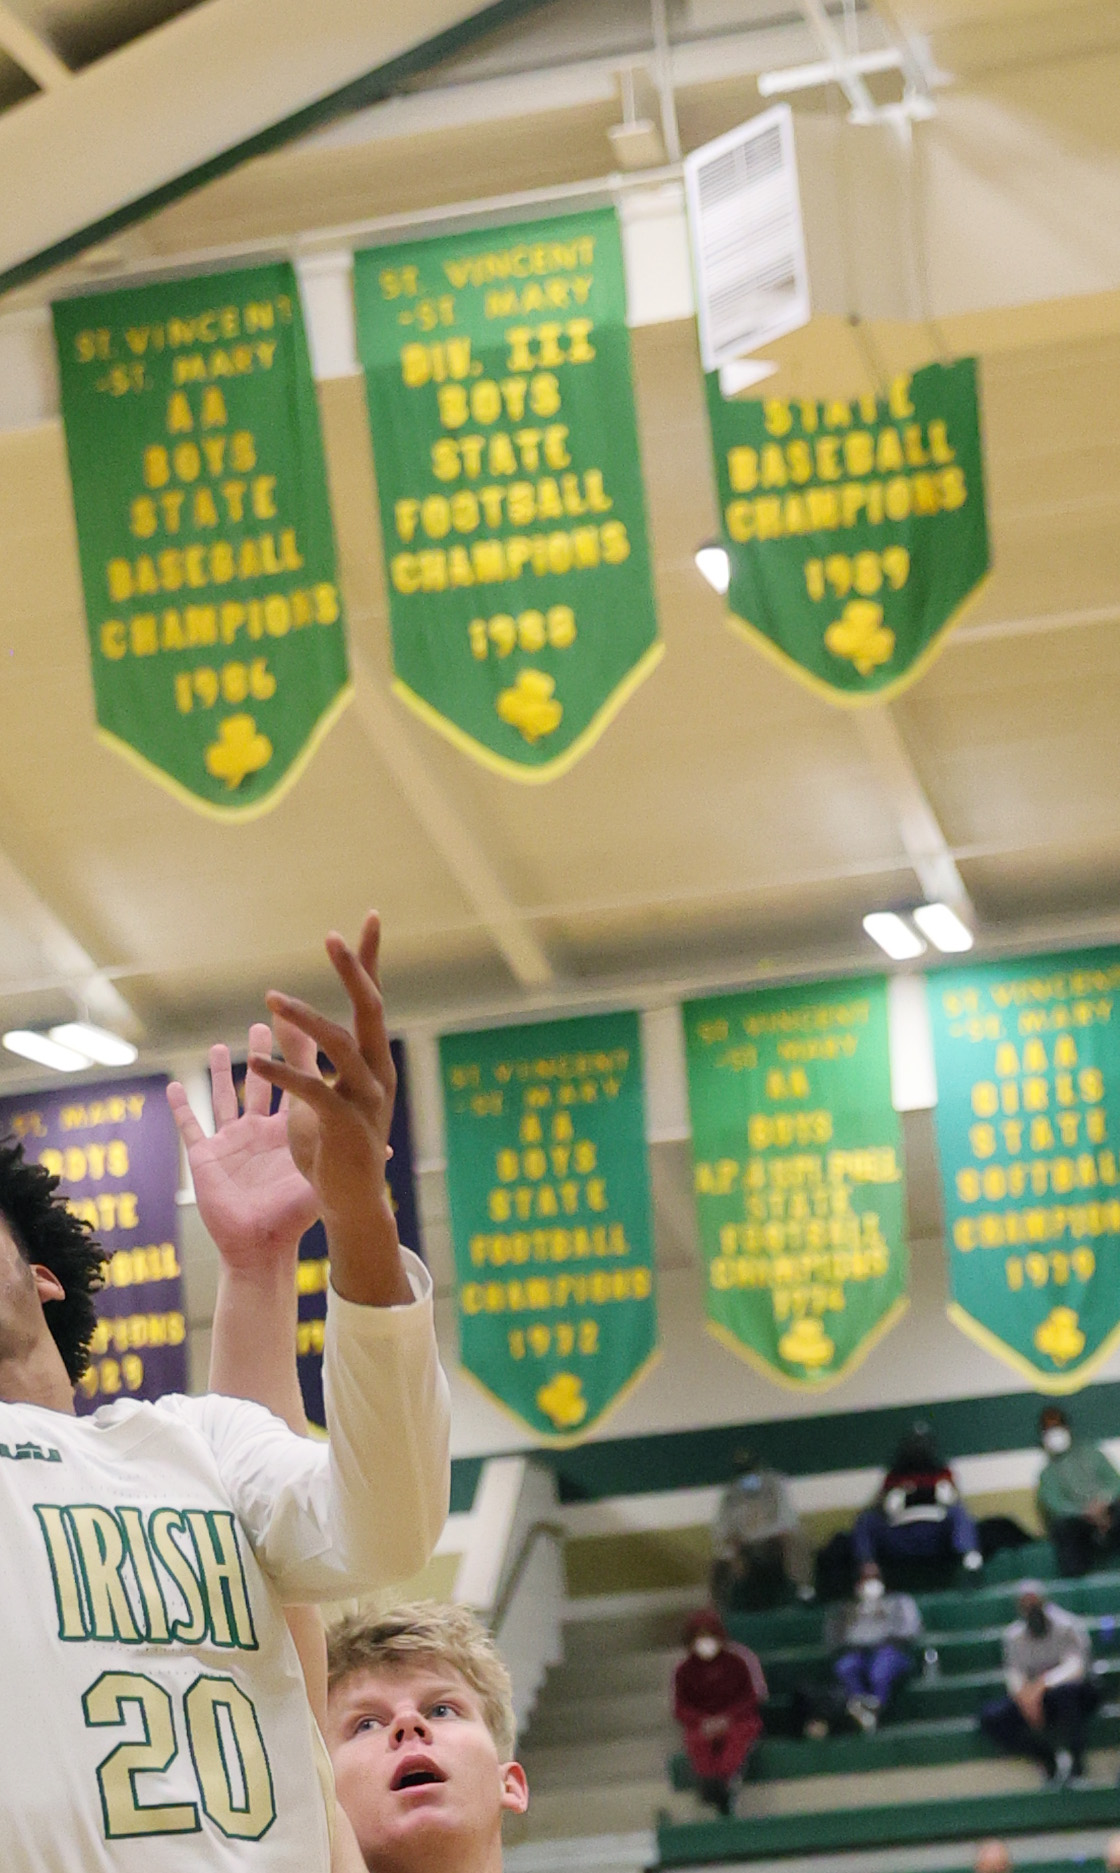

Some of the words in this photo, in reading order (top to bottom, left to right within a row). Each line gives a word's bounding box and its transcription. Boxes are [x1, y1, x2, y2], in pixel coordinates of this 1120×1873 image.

[444, 235, 596, 290] VINCENT
[485, 275, 593, 319] MARY
[173, 339, 277, 386] MARY
[400, 337, 484, 388] DIV.
[505, 318, 596, 373] III
[166, 384, 227, 434] AA
[437, 371, 561, 429] BOYS
[144, 430, 255, 489] BOYS
[431, 423, 571, 482] STATE
[726, 420, 956, 493] BASEBALL
[130, 474, 278, 539] STATE
[395, 468, 613, 543] FOOTBALL
[726, 465, 967, 542] CHAMPIONS
[107, 528, 303, 602] BASEBALL
[391, 520, 630, 595] CHAMPIONS
[100, 582, 340, 661] CHAMPIONS
[994, 1032, 1079, 1079] AAA
[60, 1093, 146, 1131] MARY
[970, 1066, 1104, 1120] GIRLS
[520, 1110, 574, 1145] AA
[968, 1106, 1107, 1159] STATE
[39, 1139, 129, 1183] BOYS
[496, 1139, 597, 1183] BOYS
[489, 1177, 609, 1223] STATE
[470, 1222, 630, 1268] FOOTBALL
[461, 1265, 652, 1315] CHAMPIONS
[33, 1503, 259, 1650] IRISH
[81, 1670, 277, 1841] 20
